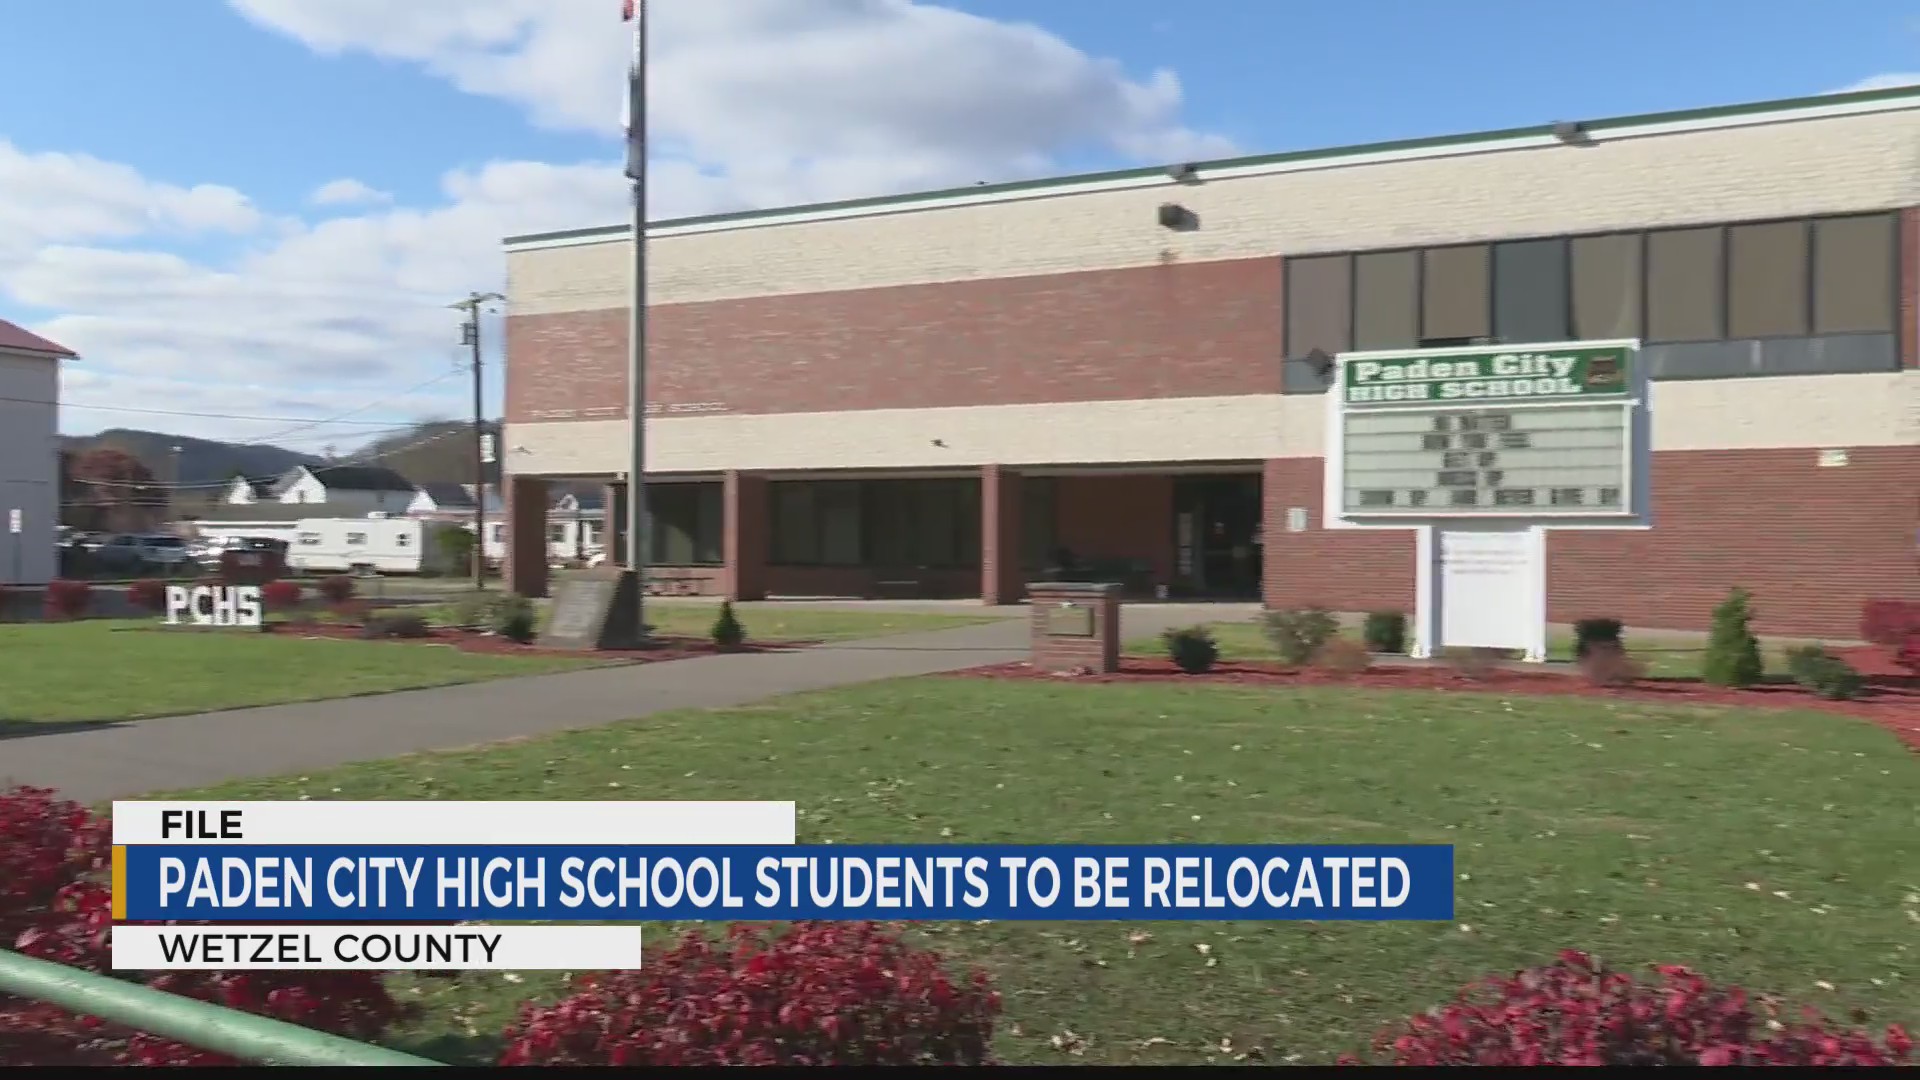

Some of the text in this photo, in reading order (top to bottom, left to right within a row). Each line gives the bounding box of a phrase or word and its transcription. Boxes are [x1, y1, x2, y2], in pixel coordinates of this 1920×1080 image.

[1355, 354, 1578, 381] Paden City
[1349, 378, 1582, 401] HIGH SCHOOL
[164, 586, 262, 625] PCHS
